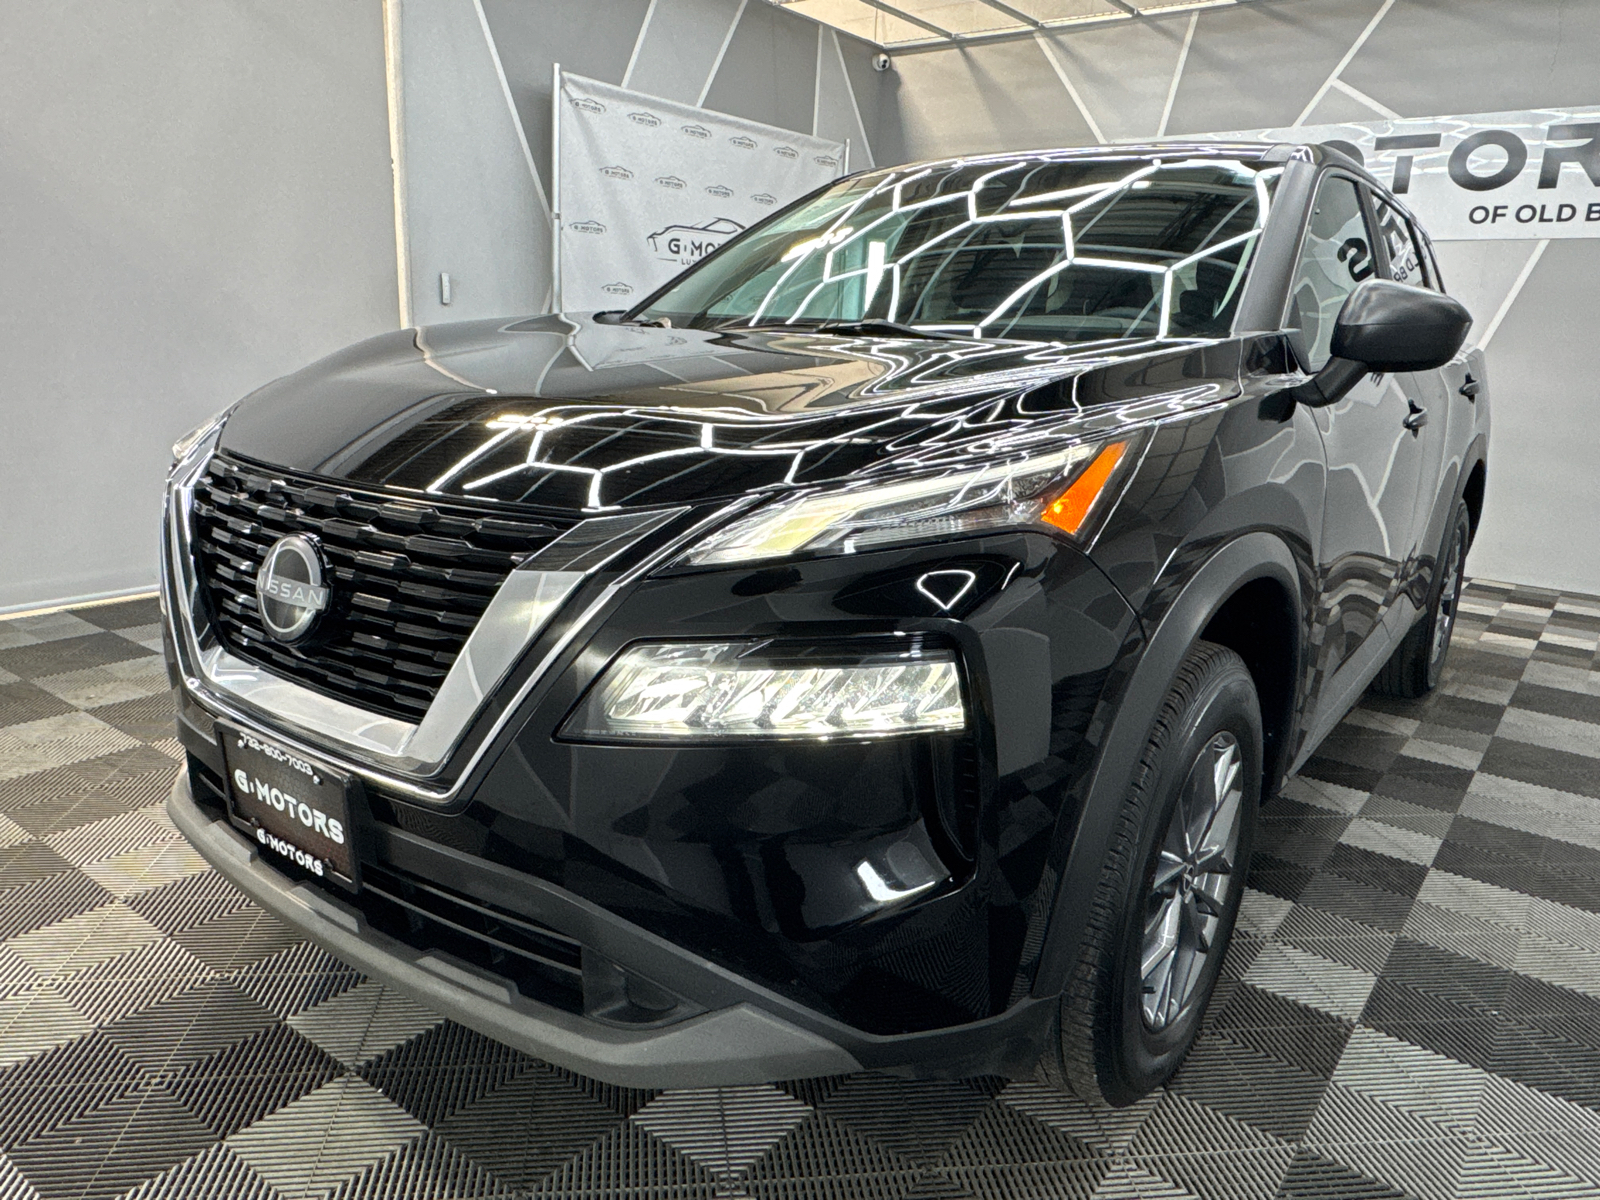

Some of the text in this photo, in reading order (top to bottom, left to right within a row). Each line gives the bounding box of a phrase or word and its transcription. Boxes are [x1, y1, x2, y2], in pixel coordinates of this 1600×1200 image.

[1320, 123, 1600, 194] TOR
[1469, 206, 1508, 224] OF
[1515, 204, 1577, 223] OLD
[580, 226, 603, 234] MOTORS
[691, 239, 722, 257] MO
